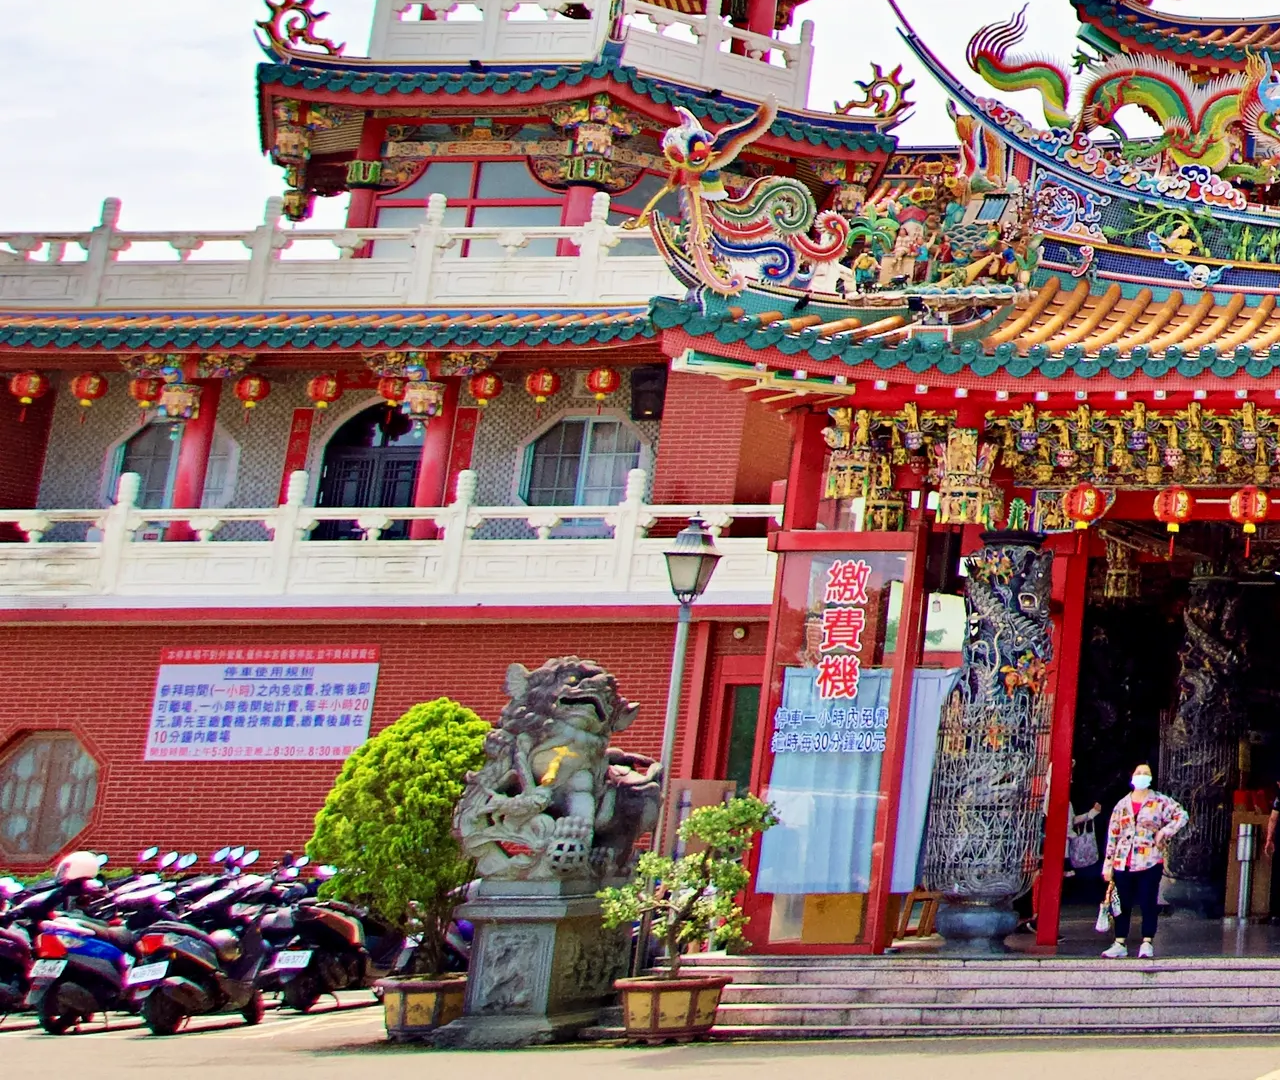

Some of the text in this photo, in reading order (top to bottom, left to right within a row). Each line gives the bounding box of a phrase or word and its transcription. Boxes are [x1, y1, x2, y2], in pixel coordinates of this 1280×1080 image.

[816, 559, 872, 700] 繳費機
[223, 666, 315, 678] 停車使用規則
[774, 707, 889, 728] 停車一小時內免費
[153, 730, 232, 744] 10分鐘內離場
[771, 731, 887, 752] 逾時每30分鐘20元
